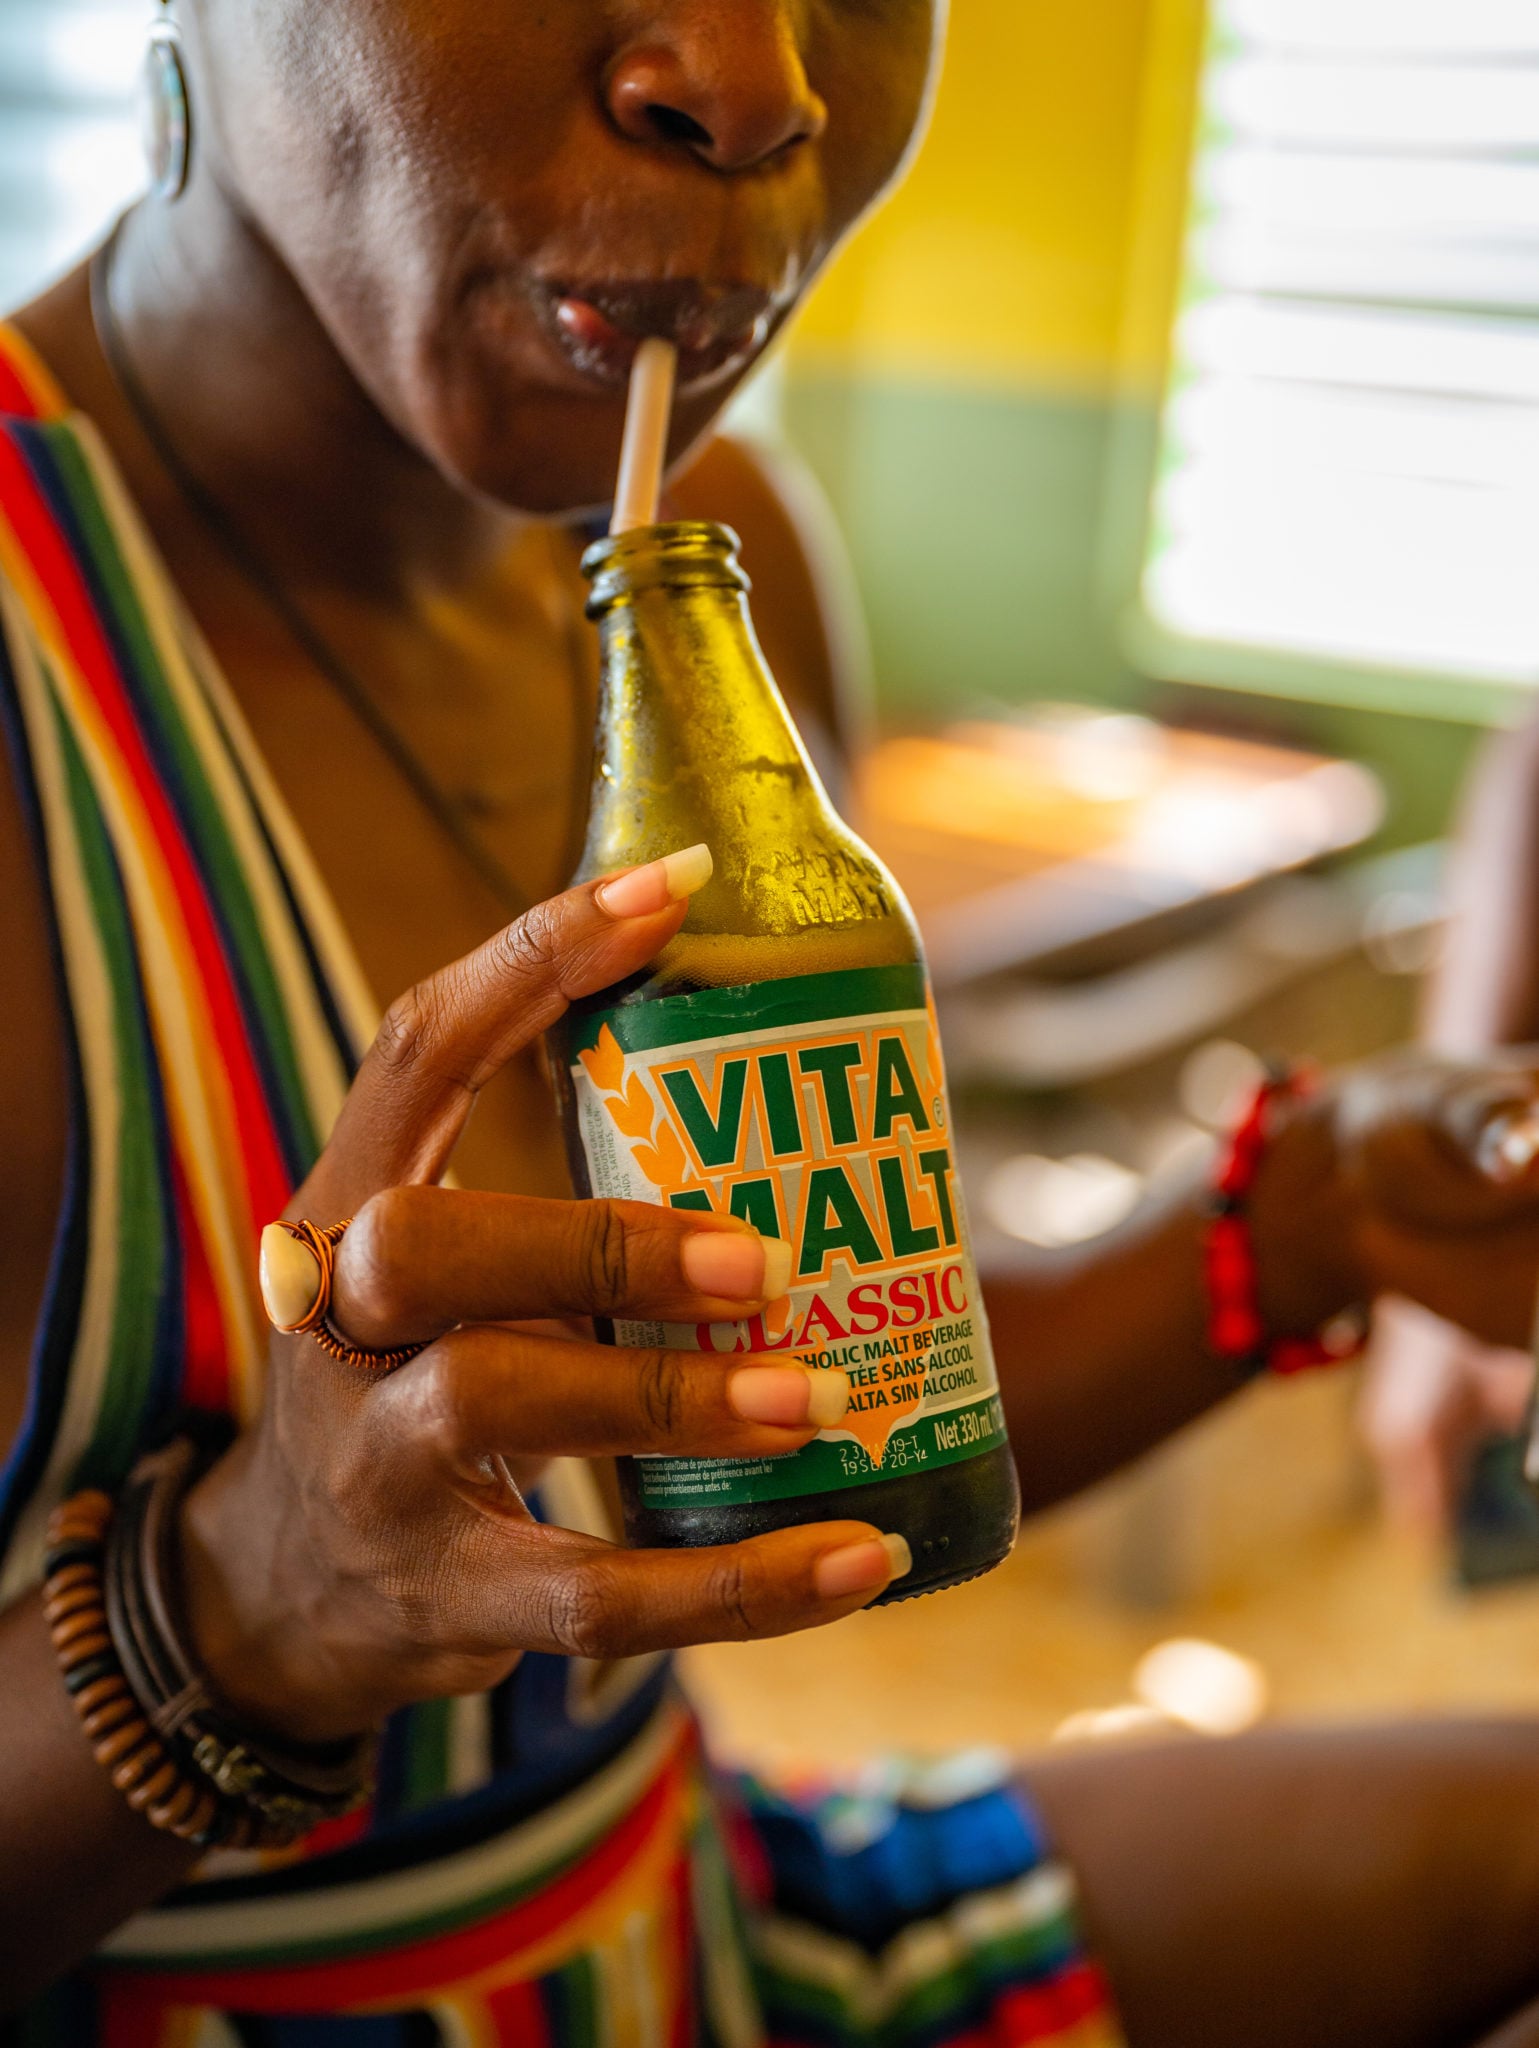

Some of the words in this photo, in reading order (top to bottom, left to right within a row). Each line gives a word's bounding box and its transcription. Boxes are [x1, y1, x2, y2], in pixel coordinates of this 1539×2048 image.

[660, 1036, 931, 1167] VITA
[793, 1345, 861, 1370] HOLIC
[863, 1335, 909, 1360] MALT
[913, 1319, 973, 1350] BEVERAGE
[847, 1364, 879, 1388] TÉE
[881, 1356, 926, 1382] SANS
[929, 1344, 973, 1371] ALCOOL
[846, 1390, 889, 1414] ALTA
[892, 1382, 919, 1404] SIN
[922, 1367, 977, 1397] ALCOHOL
[933, 1419, 959, 1451] Net
[958, 1411, 981, 1444] 330
